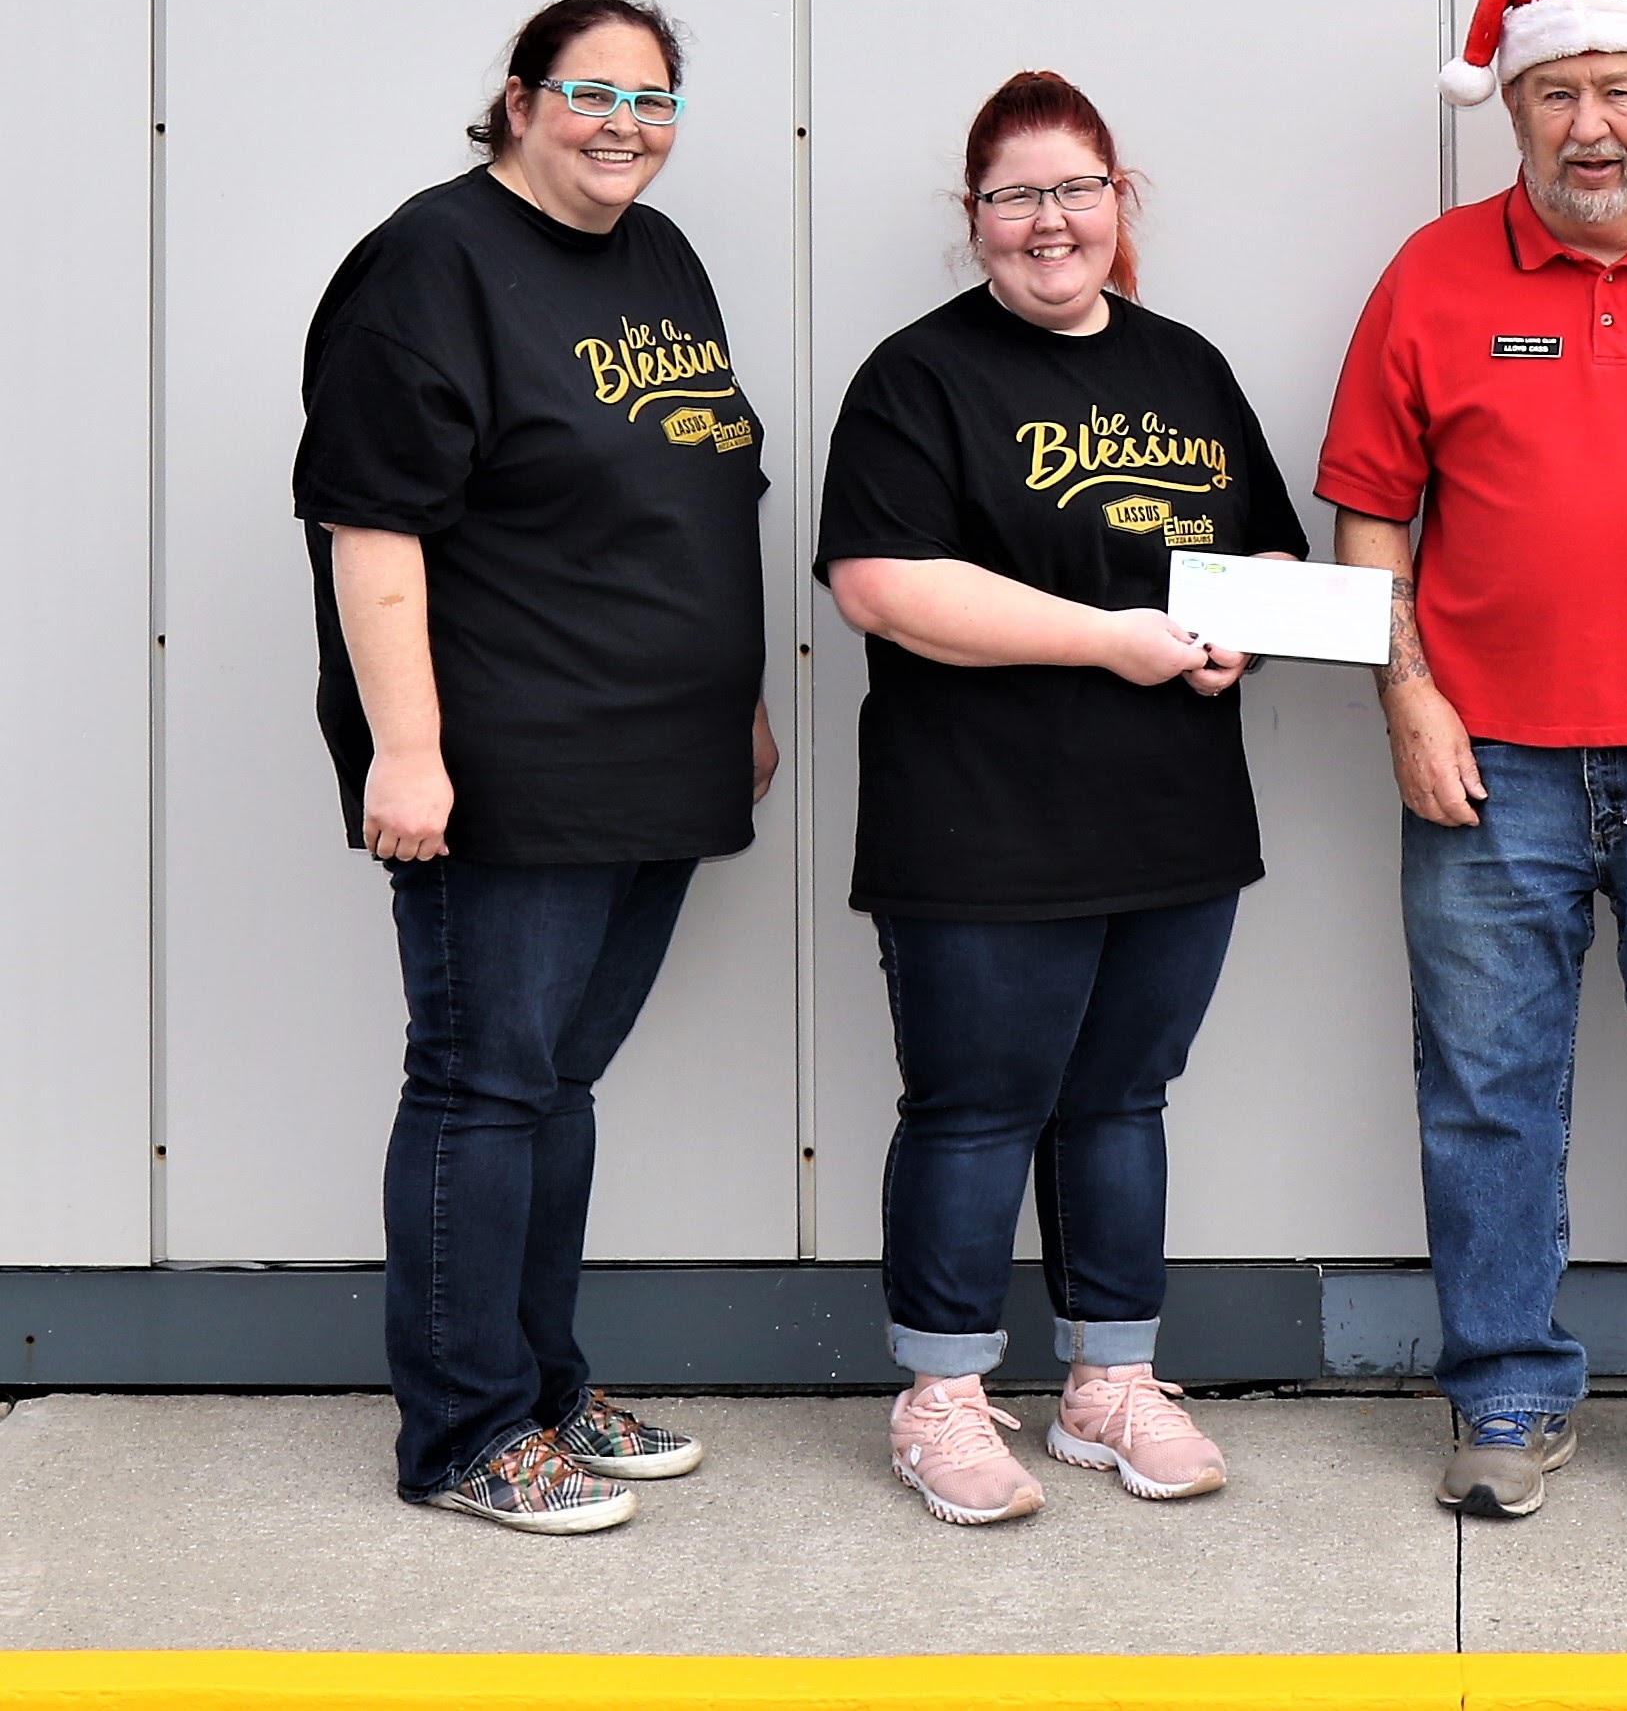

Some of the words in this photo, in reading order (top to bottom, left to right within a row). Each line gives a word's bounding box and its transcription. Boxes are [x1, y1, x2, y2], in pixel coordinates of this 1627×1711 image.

[620, 314, 656, 350] be
[574, 333, 738, 404] Blessin
[671, 415, 708, 438] LASSUS
[711, 416, 751, 442] Elmo's
[1091, 404, 1130, 436] be
[1015, 421, 1233, 490] Blessing
[1116, 505, 1161, 523] LASSUS
[1163, 514, 1214, 536] Elmo's
